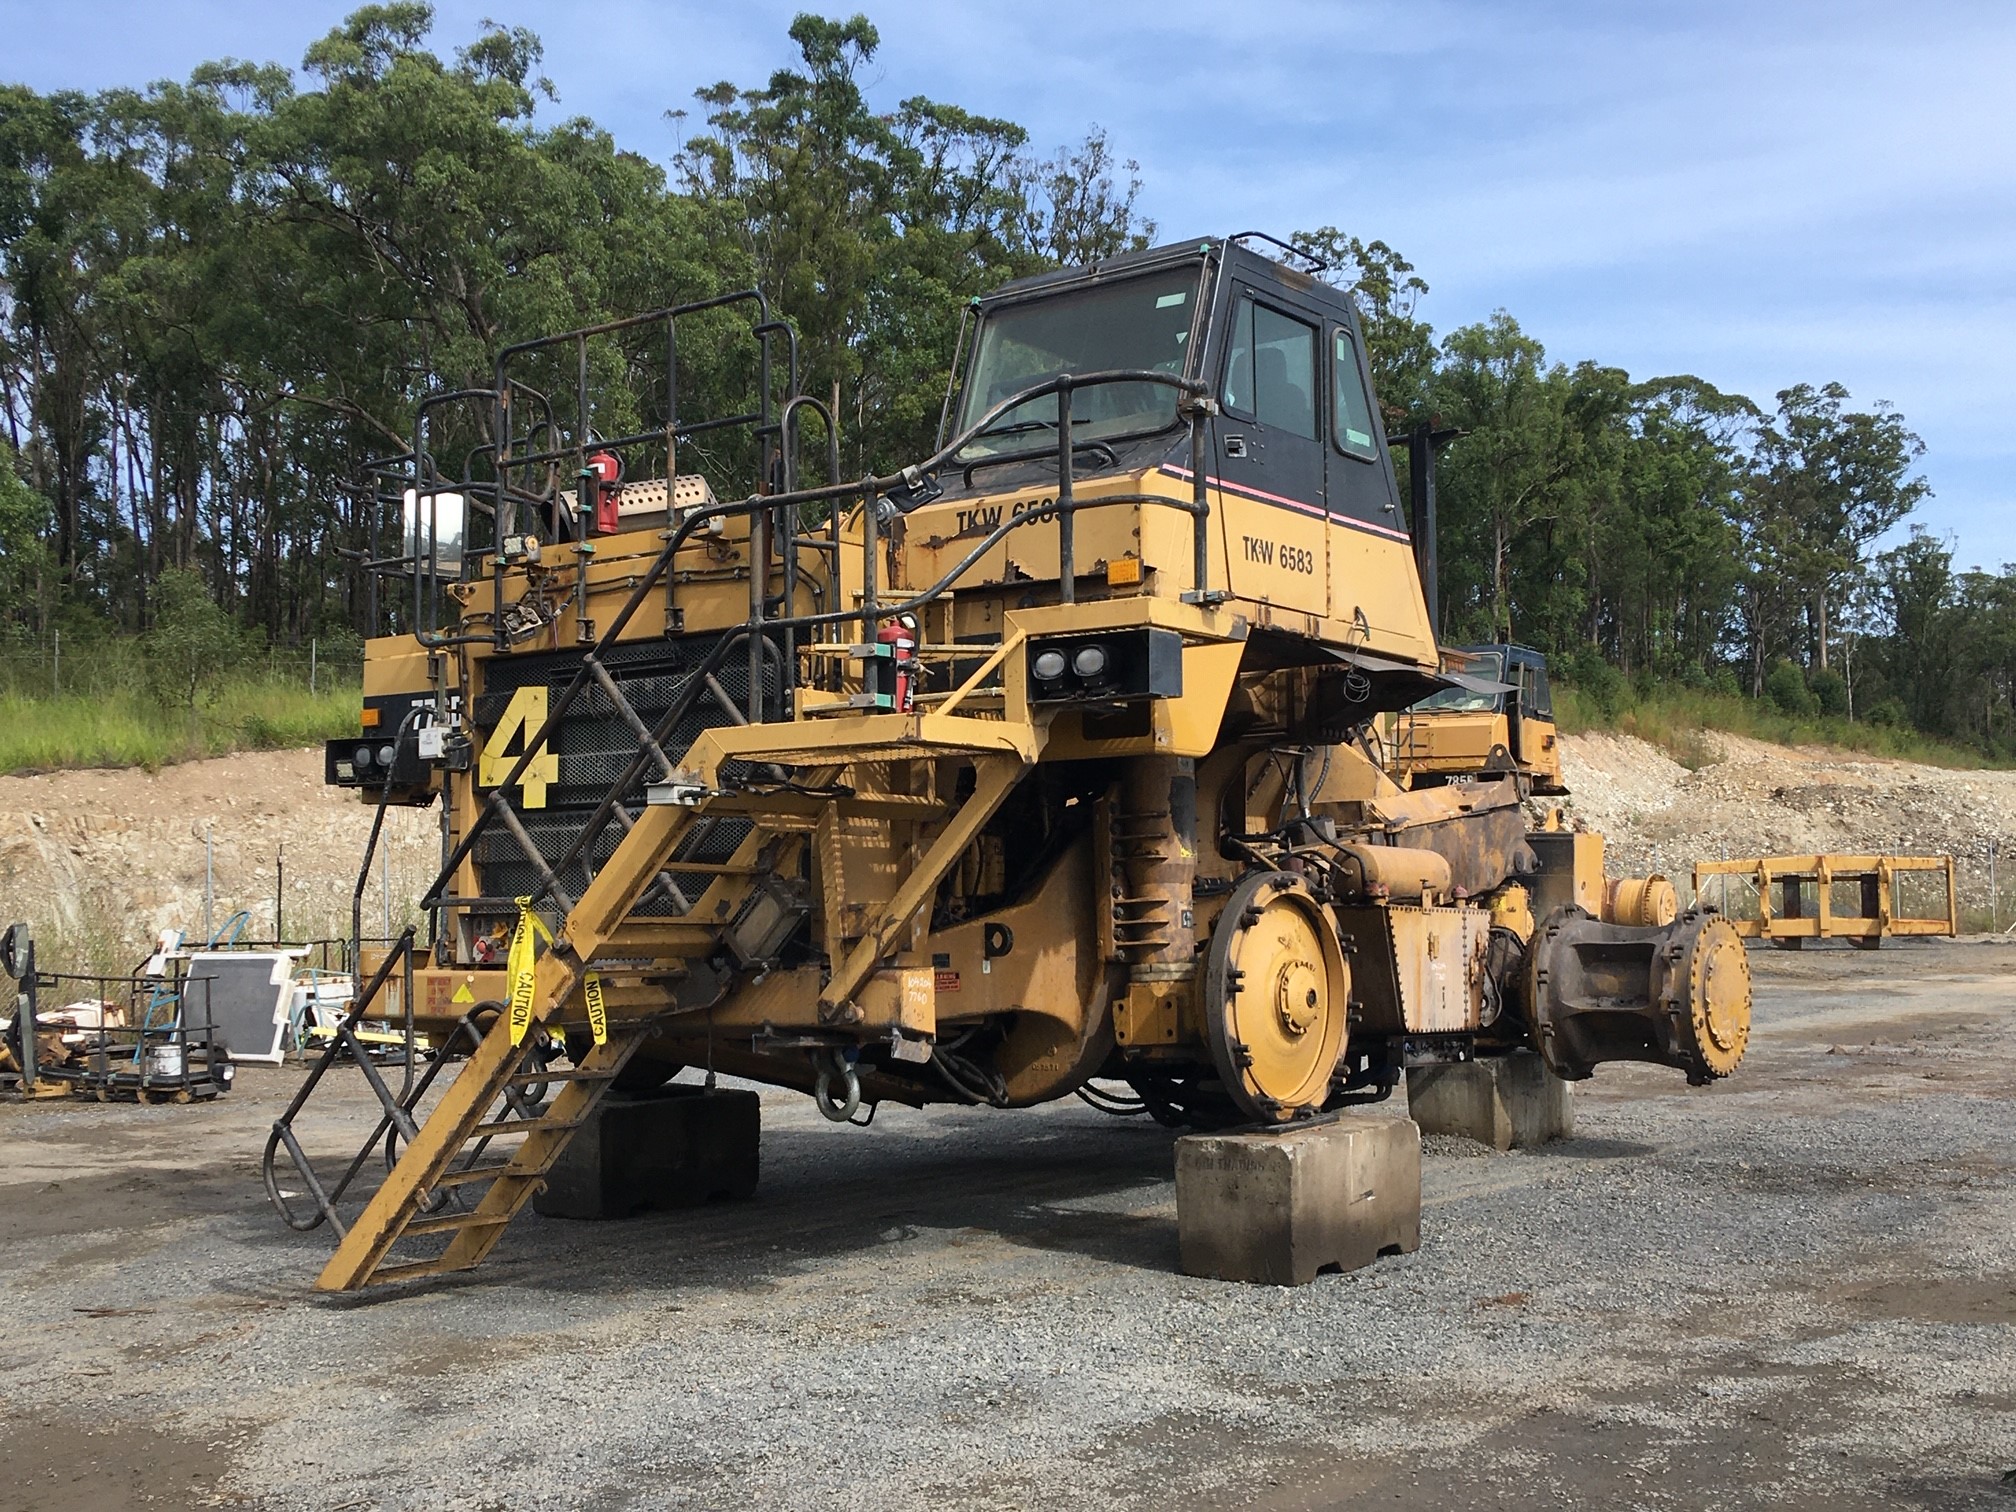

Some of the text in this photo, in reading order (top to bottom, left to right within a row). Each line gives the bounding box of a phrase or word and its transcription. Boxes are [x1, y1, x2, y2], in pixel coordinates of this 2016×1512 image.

[956, 505, 1003, 532] TKW
[1242, 535, 1313, 575] TKW 6583
[479, 686, 559, 809] 4
[512, 972, 534, 1027] CAUTION
[586, 980, 604, 1037] CAUTION
